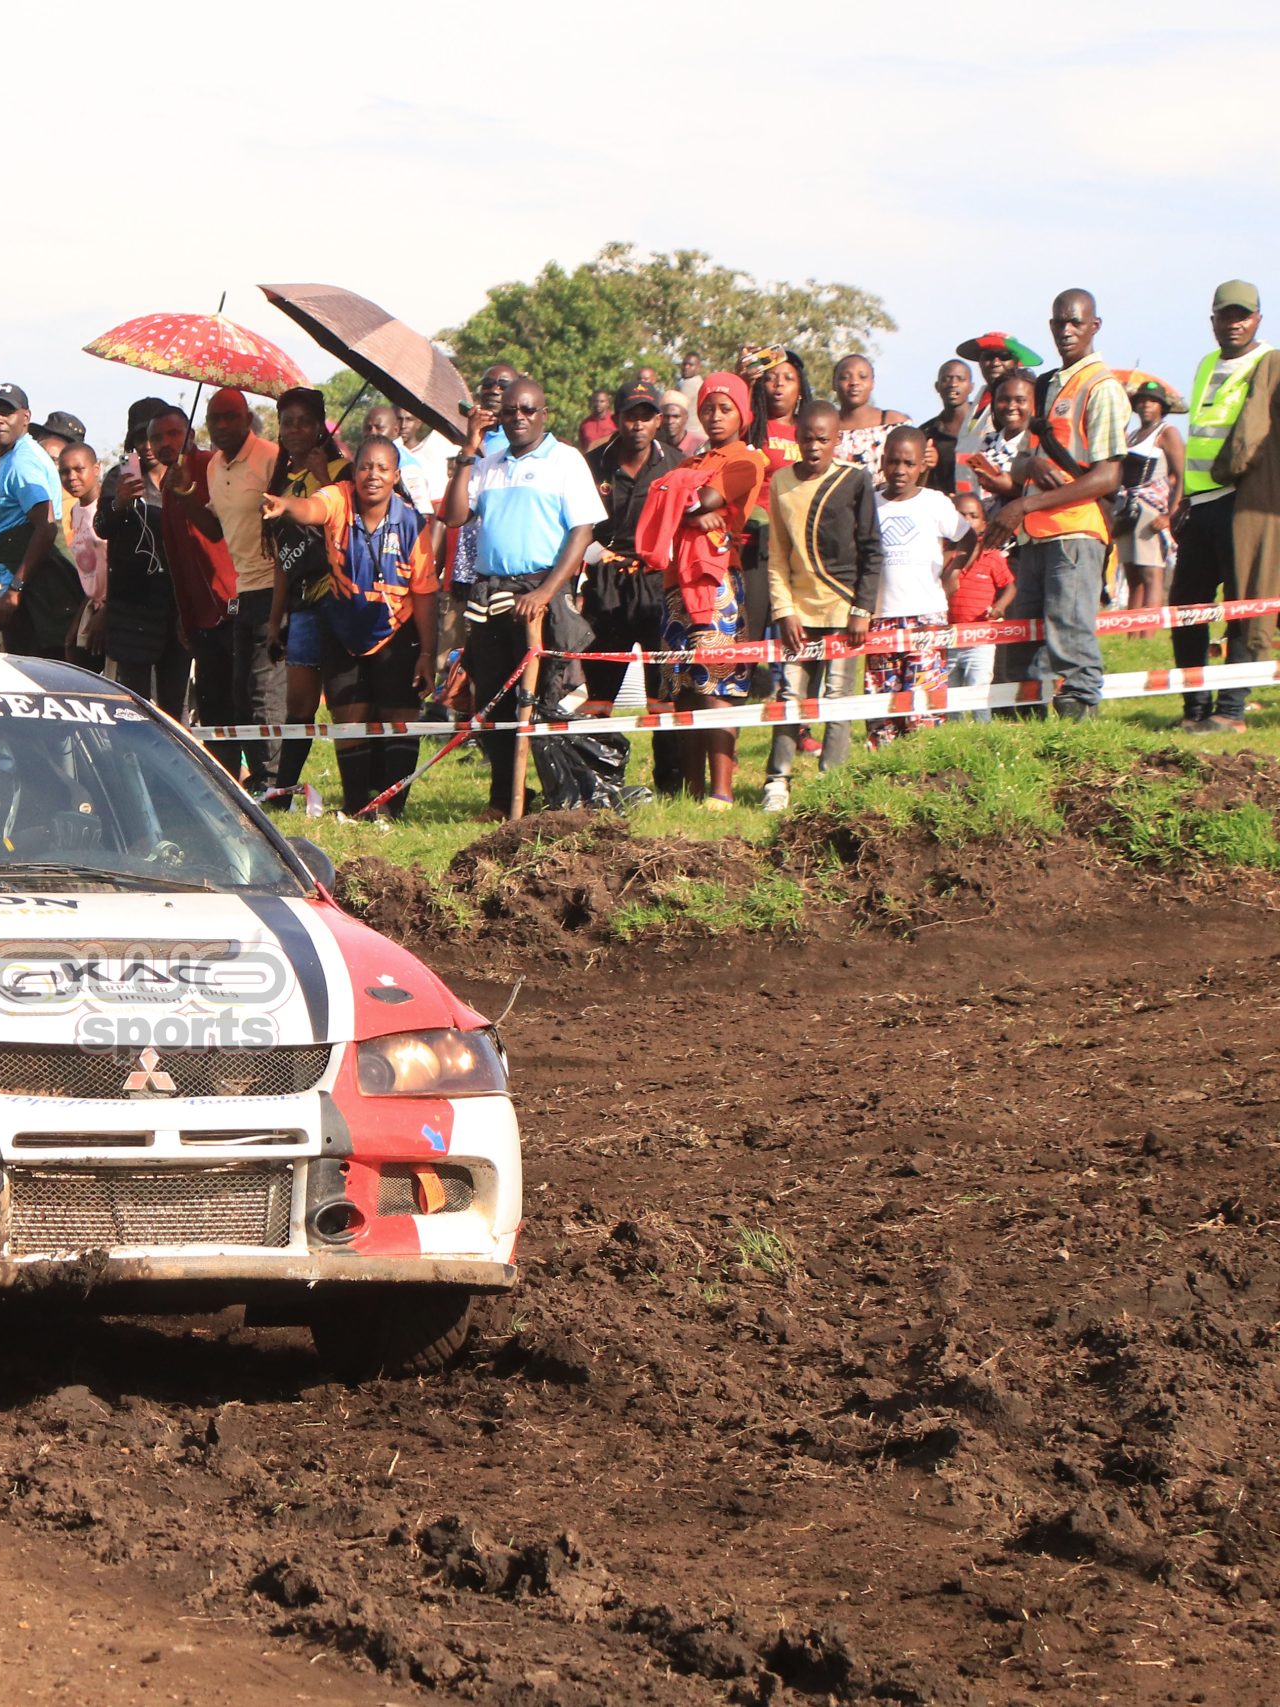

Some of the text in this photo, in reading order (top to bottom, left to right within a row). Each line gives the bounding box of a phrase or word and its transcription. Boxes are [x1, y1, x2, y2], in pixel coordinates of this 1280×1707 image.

[962, 626, 1026, 641] Ice-Cold
[701, 644, 764, 660] Ice-Cold
[60, 962, 223, 986] KAC
[179, 986, 240, 998] SPARES
